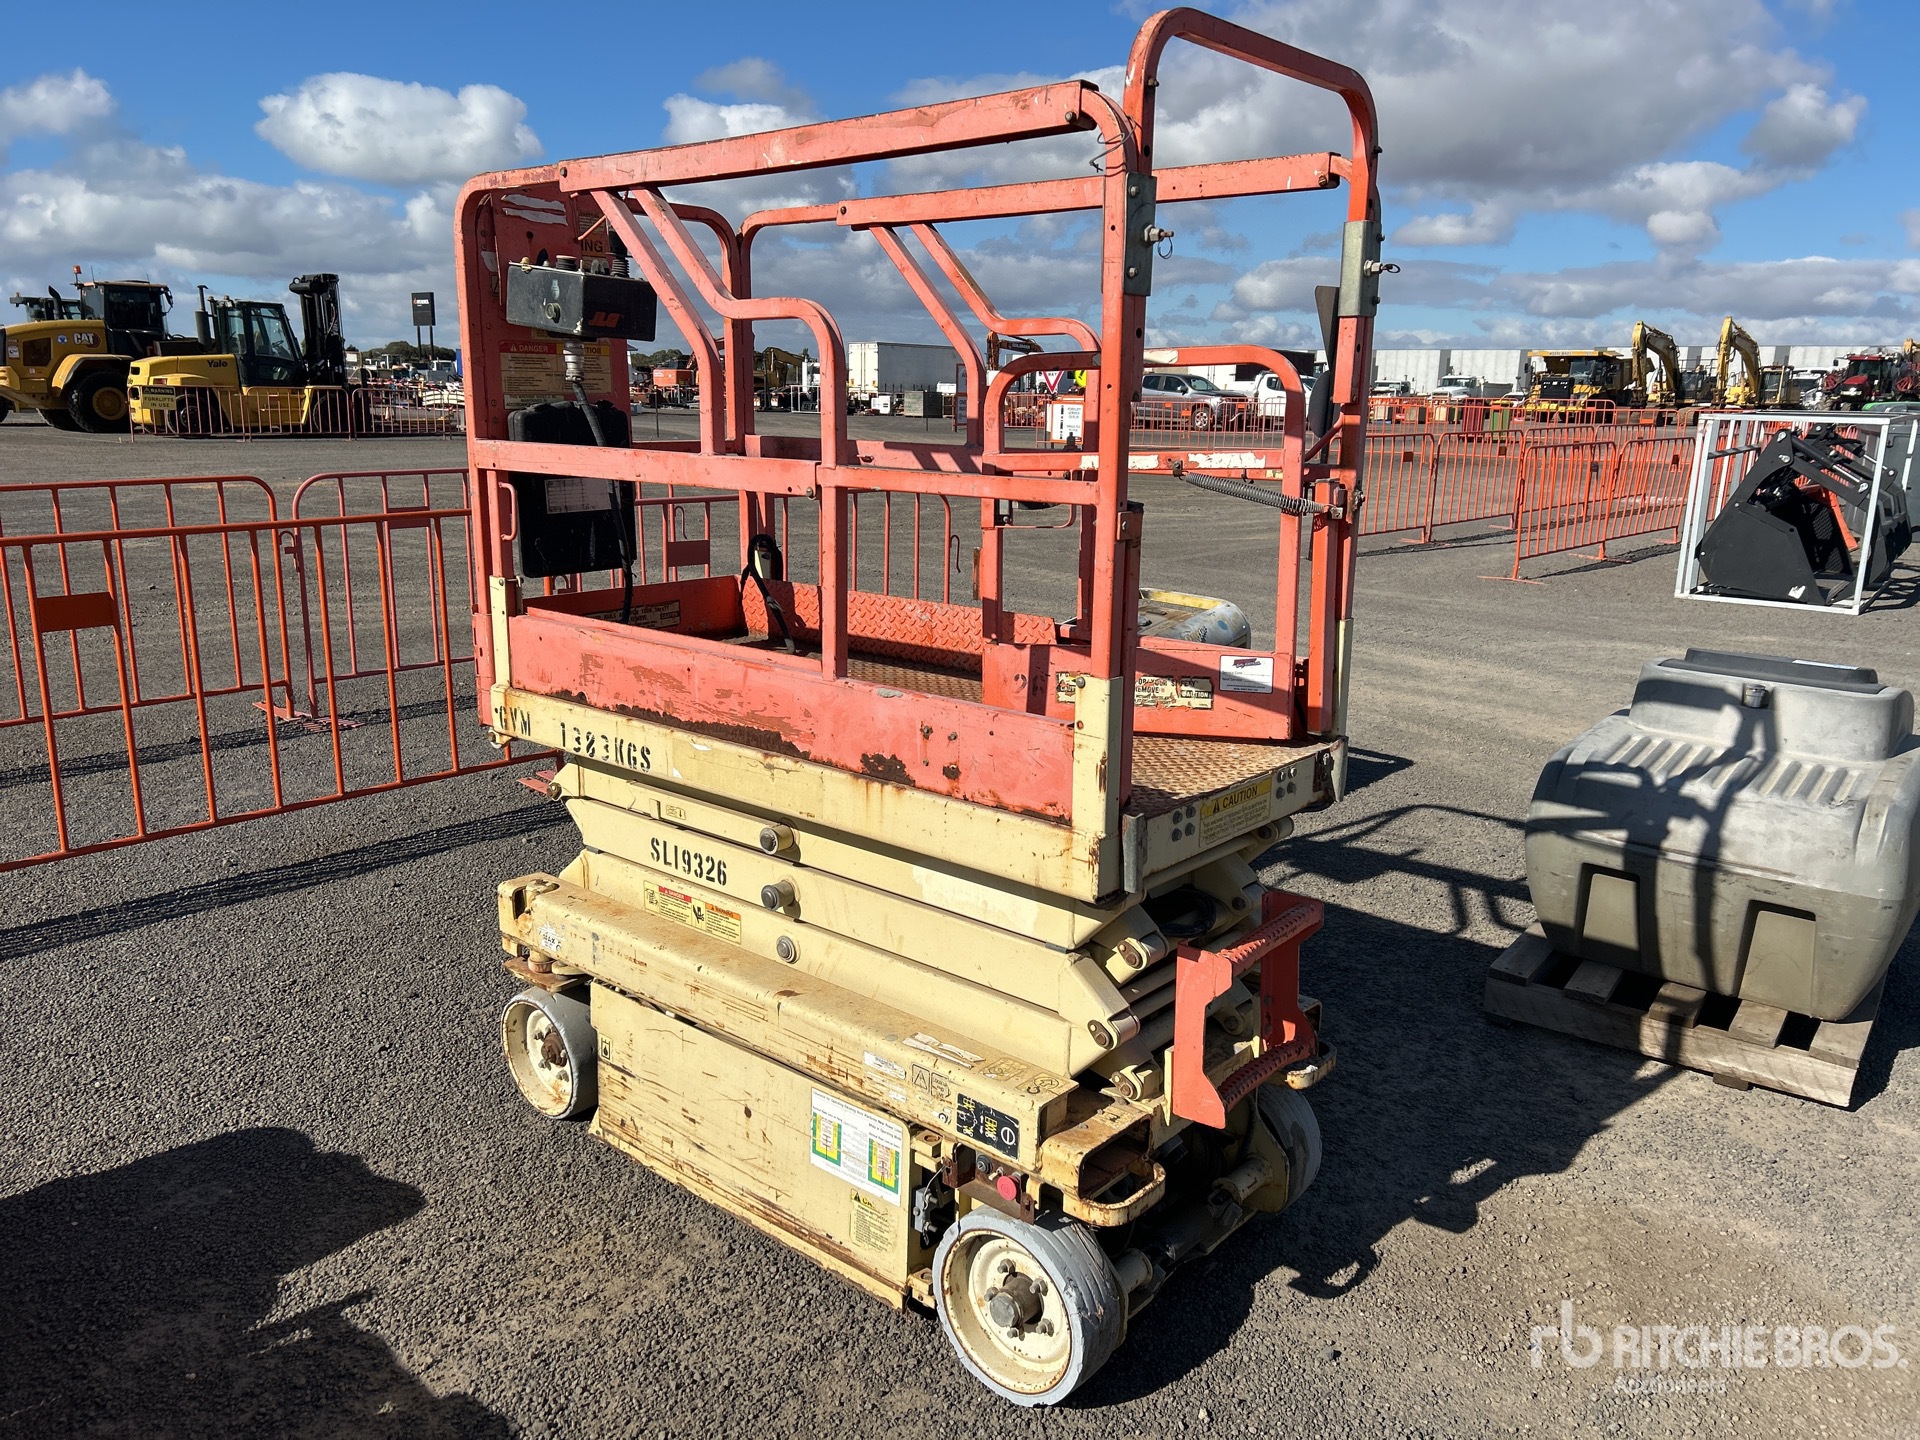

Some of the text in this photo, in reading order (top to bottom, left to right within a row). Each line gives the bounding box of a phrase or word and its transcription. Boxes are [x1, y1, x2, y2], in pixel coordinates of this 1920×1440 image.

[588, 311, 622, 328] JLG
[73, 333, 94, 345] CAT
[207, 360, 228, 368] Yale
[1180, 690, 1209, 698] CAUTION
[499, 705, 531, 737] GVM
[1222, 786, 1258, 809] CAUTION
[668, 889, 685, 900] DANGER
